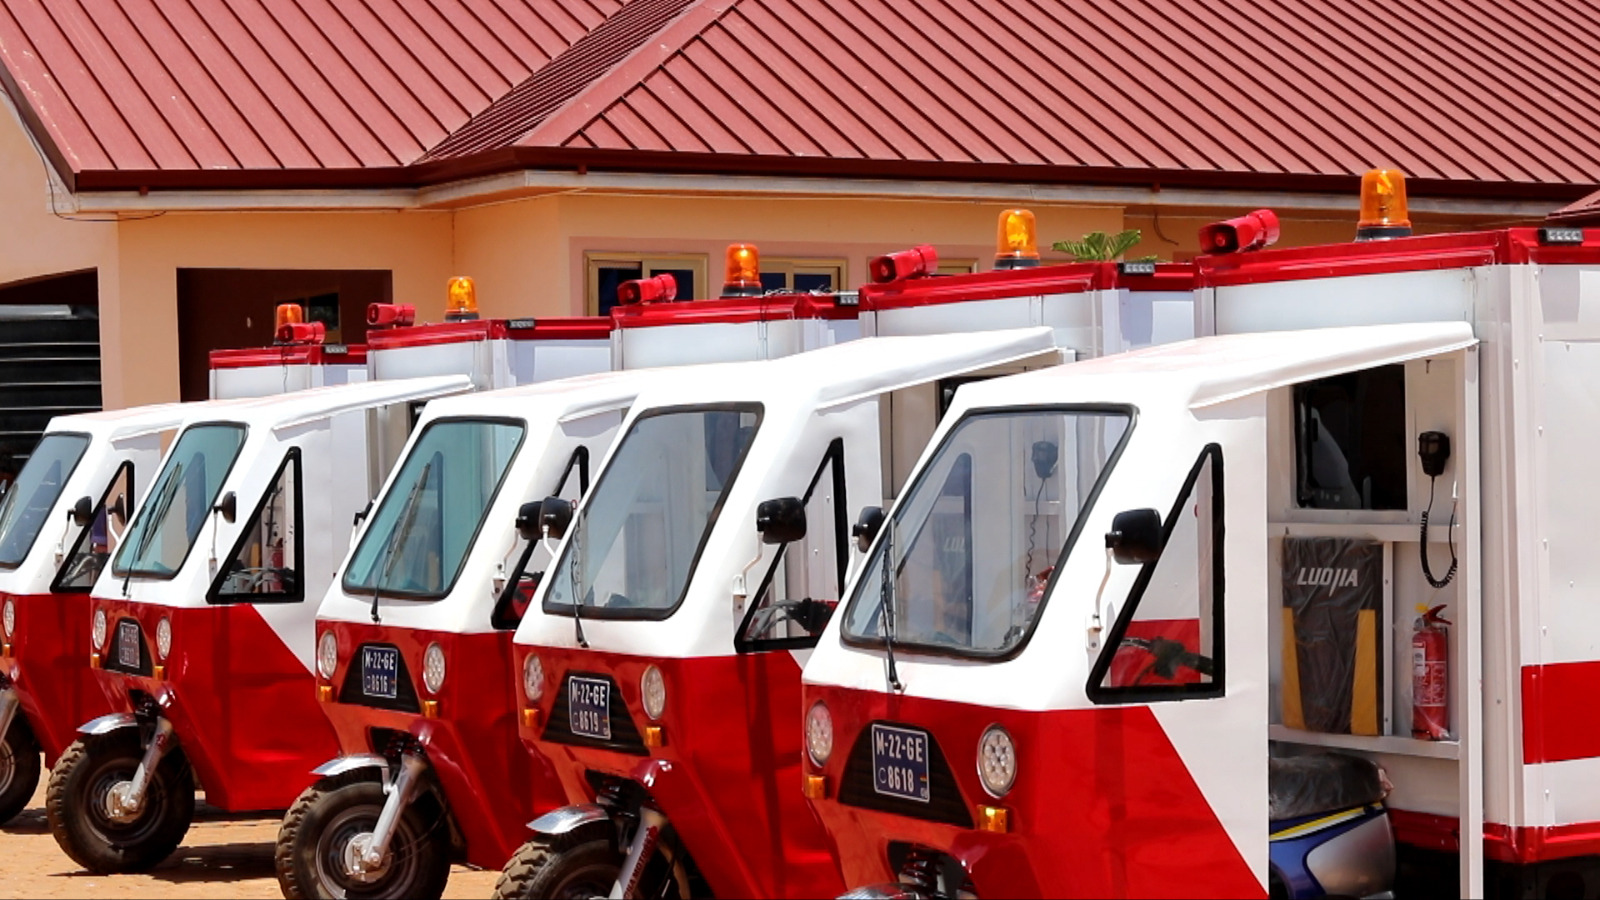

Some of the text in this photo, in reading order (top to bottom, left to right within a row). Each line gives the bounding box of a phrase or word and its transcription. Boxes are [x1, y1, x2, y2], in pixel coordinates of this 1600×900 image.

[1296, 567, 1358, 597] LUOJIA
[365, 651, 395, 670] M-22-GE
[572, 682, 606, 707] M-22-GE
[876, 731, 923, 762] M-22-GE
[887, 765, 915, 793] 8618
